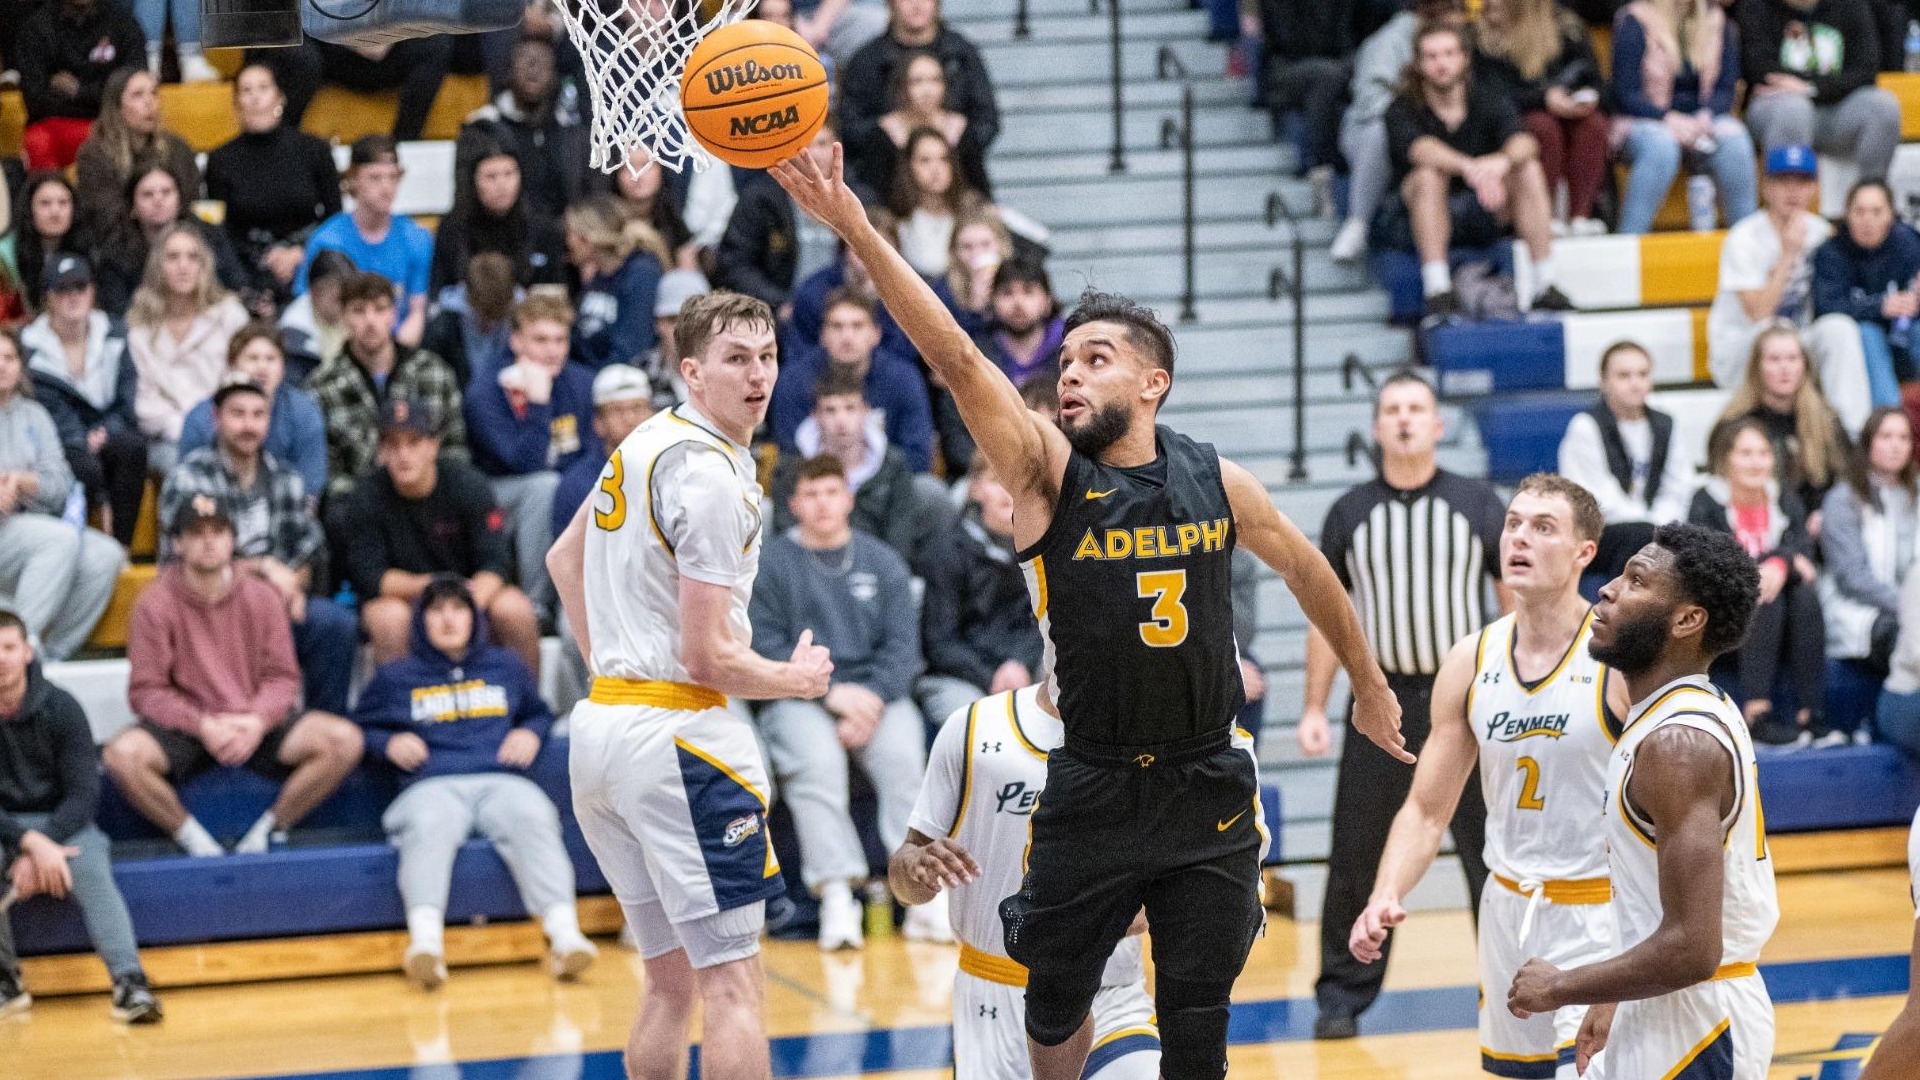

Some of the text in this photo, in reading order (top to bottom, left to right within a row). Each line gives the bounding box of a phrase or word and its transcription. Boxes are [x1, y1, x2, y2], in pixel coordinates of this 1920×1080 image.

[705, 60, 803, 95] Wilson
[730, 105, 799, 136] NCAA
[594, 449, 627, 532] 3
[1136, 569, 1189, 648] 3
[1487, 711, 1570, 740] PENMEN
[1516, 755, 1545, 811] 2
